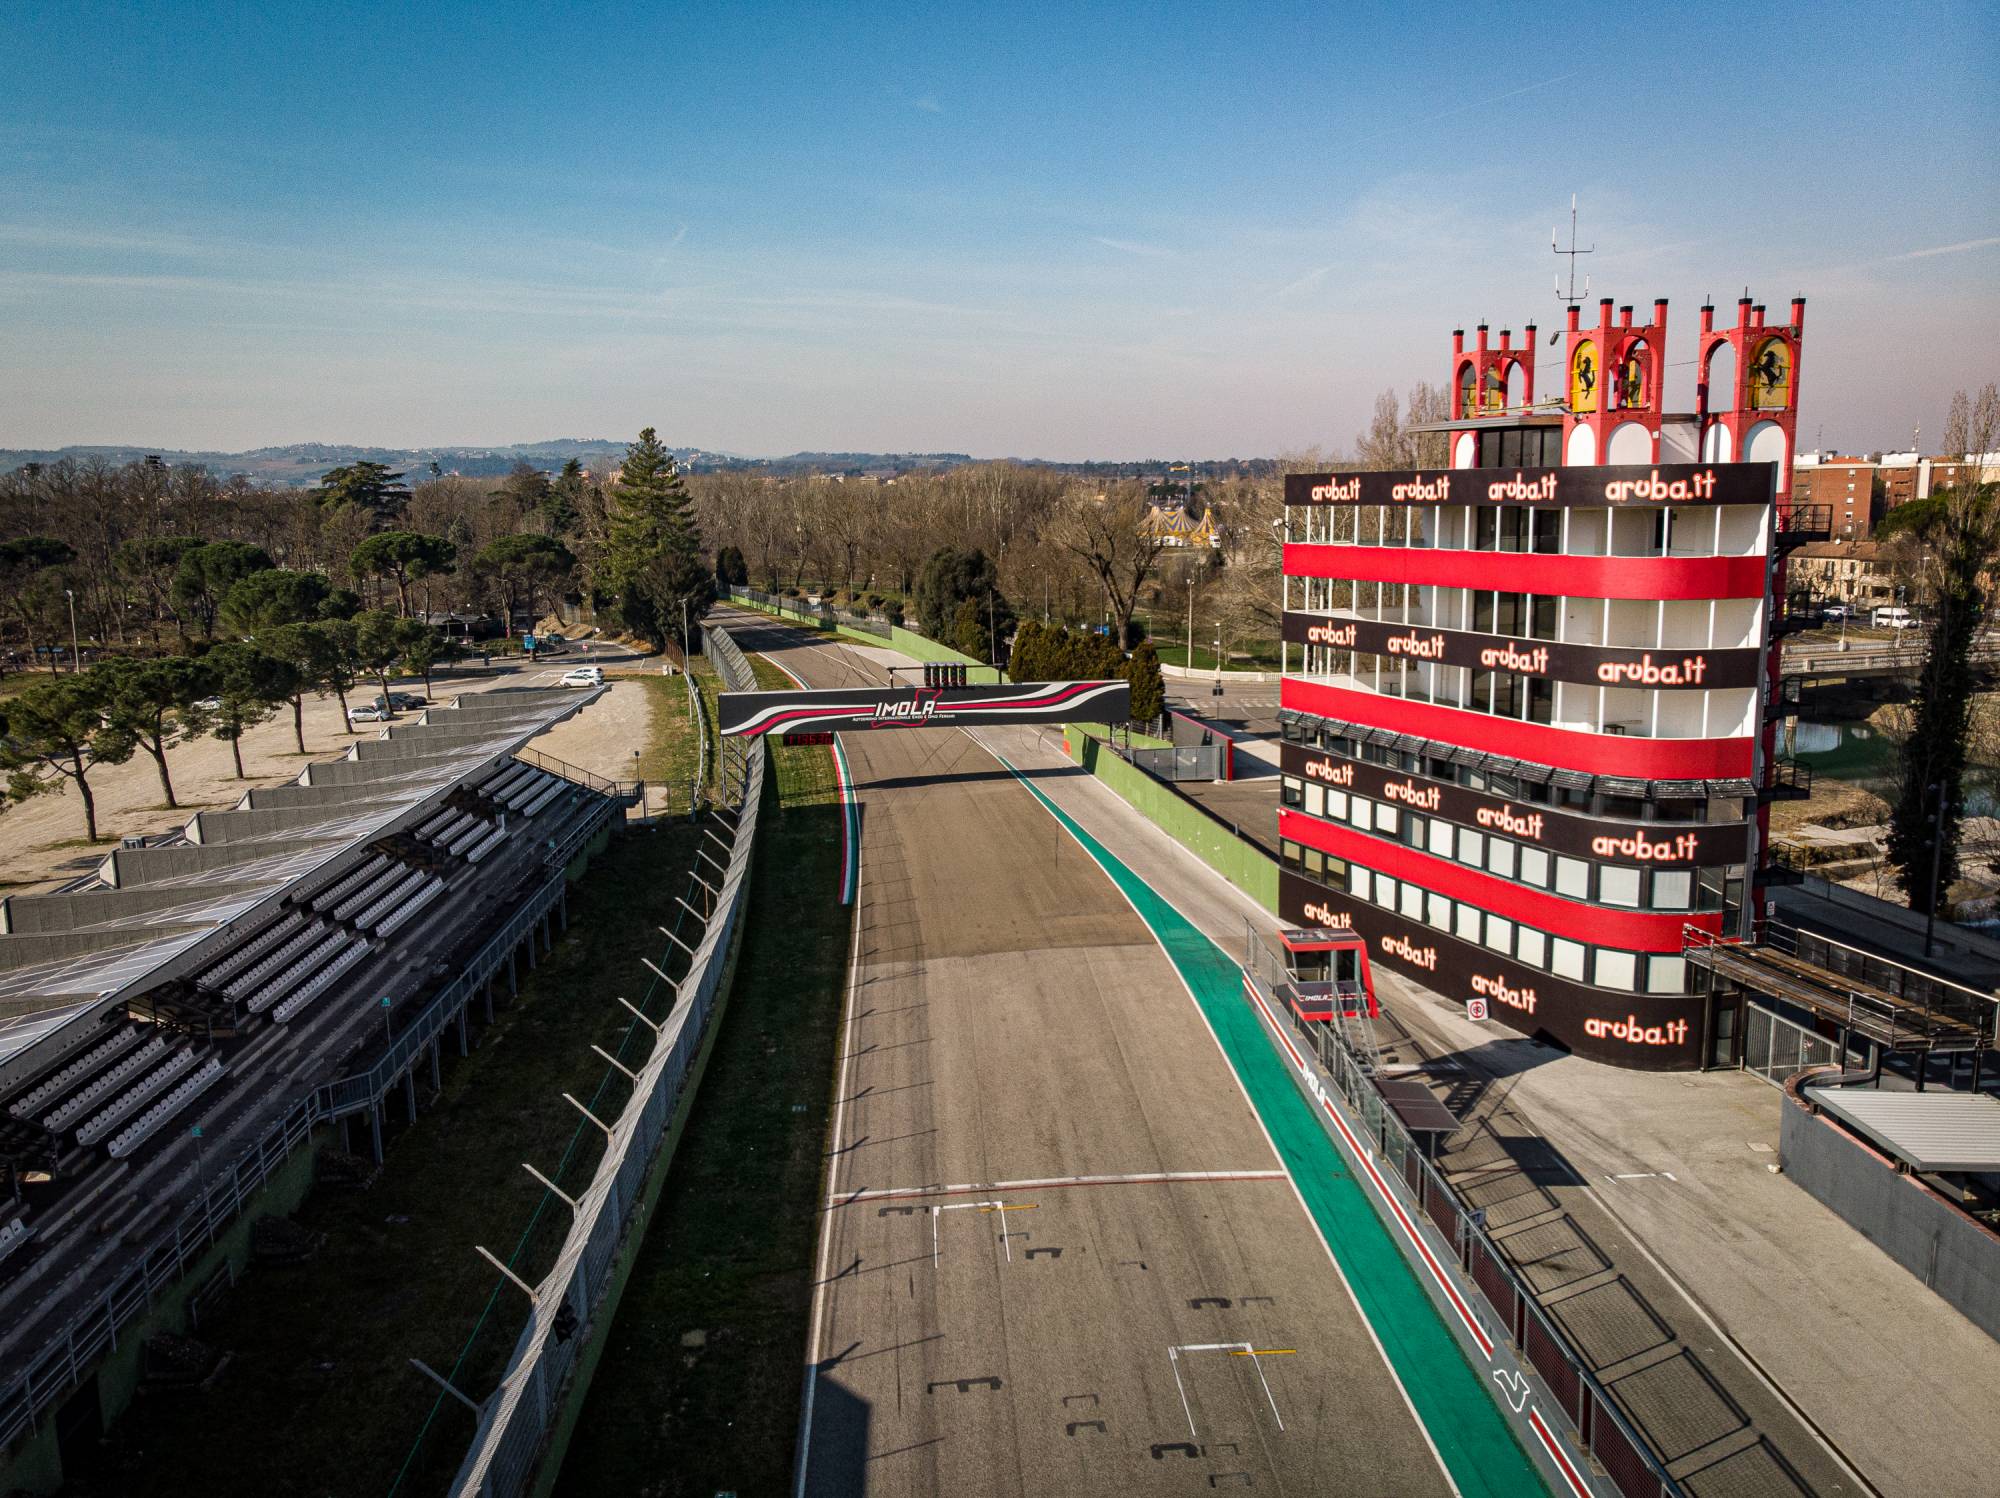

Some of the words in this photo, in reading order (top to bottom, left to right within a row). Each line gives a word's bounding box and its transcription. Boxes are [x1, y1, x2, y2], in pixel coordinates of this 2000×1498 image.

[1312, 477, 1361, 501] aruba.it
[1392, 475, 1450, 501] aruba.it
[1488, 472, 1558, 501] aruba.it
[1605, 470, 1717, 501] aruba.it
[1308, 620, 1357, 646] aruba.it
[1388, 630, 1445, 659] aruba.it
[1481, 642, 1549, 674] aruba.it
[1598, 654, 1706, 685] aruba.it
[875, 701, 936, 717] IMOLA
[1306, 757, 1354, 786] aruba.it
[1384, 778, 1440, 811] aruba.it
[1477, 803, 1543, 839] aruba.it
[1592, 831, 1698, 861] aruba.it
[1304, 901, 1351, 928] aruba.it
[1381, 934, 1437, 970] aruba.it
[1471, 973, 1537, 1013] aruba.it
[1584, 1015, 1689, 1045] aruba.it
[1303, 1062, 1326, 1106] IMOLA
